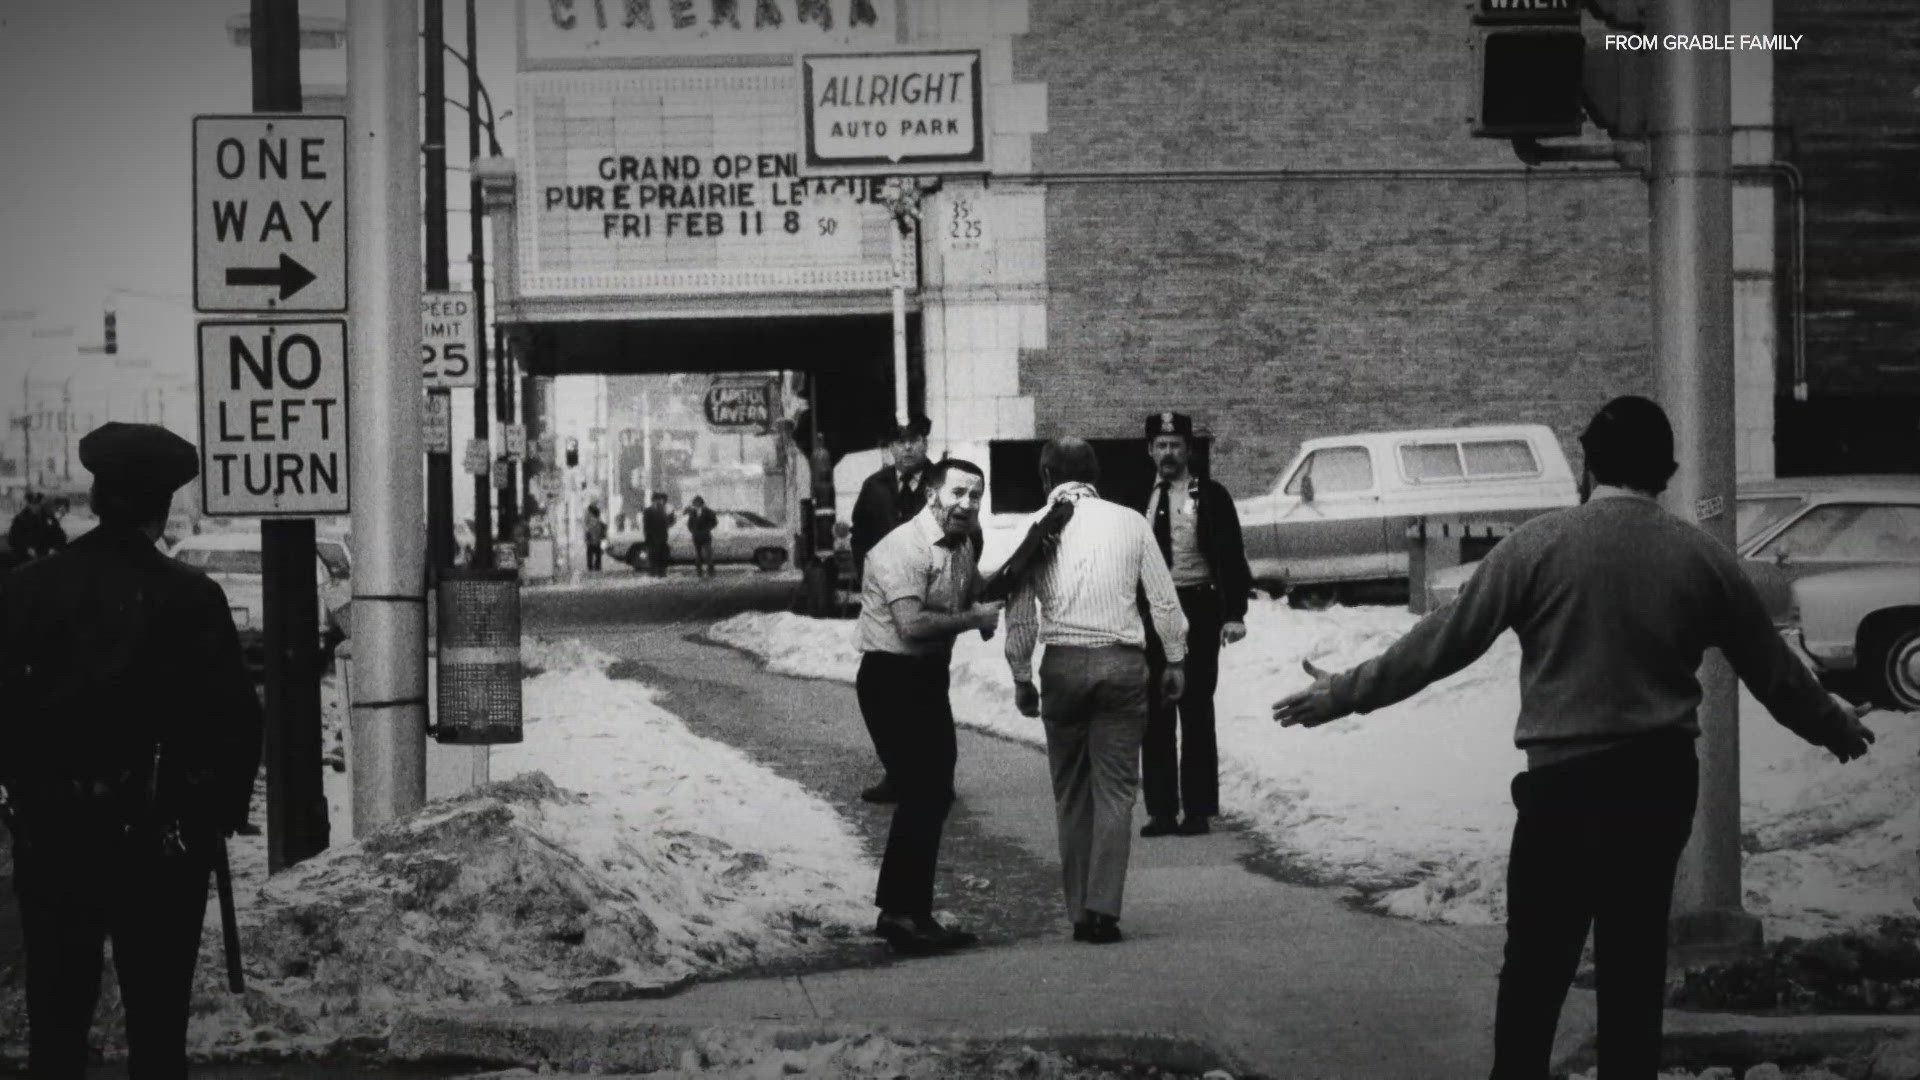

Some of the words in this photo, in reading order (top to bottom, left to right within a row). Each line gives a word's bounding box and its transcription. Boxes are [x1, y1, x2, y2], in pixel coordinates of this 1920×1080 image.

[820, 72, 964, 107] ALLRIGHT
[831, 121, 887, 137] AUTO
[901, 119, 958, 135] PARK
[217, 138, 326, 180] ONE
[599, 156, 703, 182] GRAND
[713, 154, 798, 179] OPENI
[546, 184, 630, 211] PURE
[640, 182, 754, 209] PRAIRIE
[213, 201, 332, 242] WAY
[604, 213, 650, 239] FRI
[666, 213, 723, 238] FEB
[740, 211, 762, 236] 11
[784, 210, 800, 234] 8
[421, 301, 467, 316] PEED
[424, 322, 460, 337] IMIT
[230, 333, 321, 390] NO
[422, 344, 469, 378] 25
[219, 399, 336, 442] LEFT
[213, 452, 337, 497] TURN
